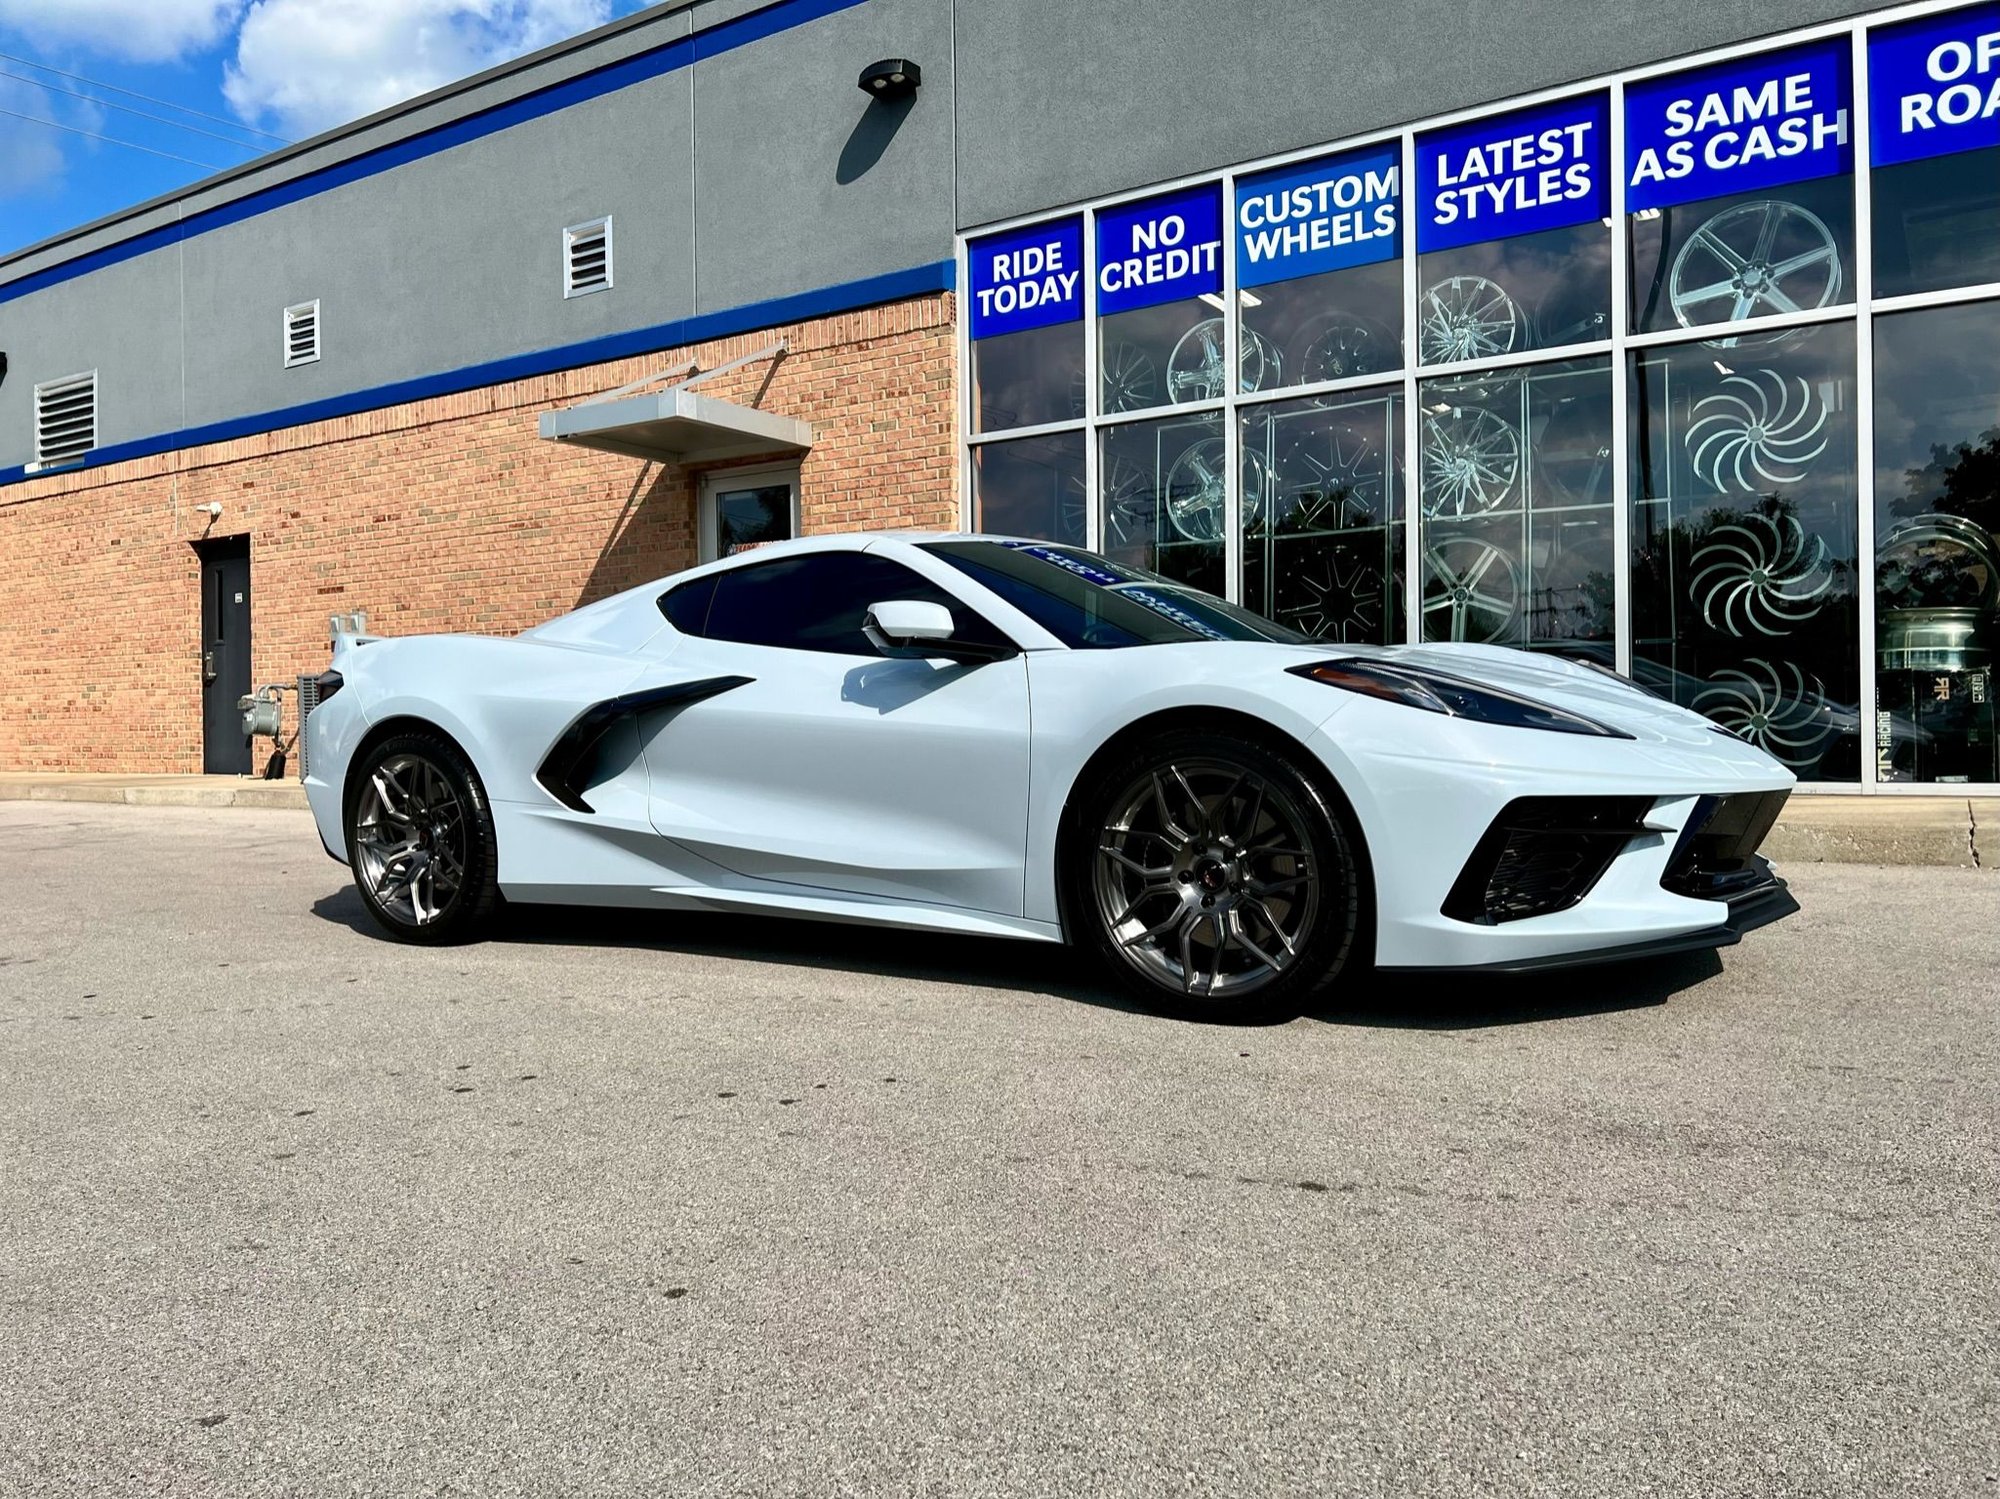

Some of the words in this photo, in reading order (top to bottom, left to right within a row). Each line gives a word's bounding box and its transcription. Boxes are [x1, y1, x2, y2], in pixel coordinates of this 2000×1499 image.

[1664, 73, 1813, 137] SAME
[1438, 121, 1593, 187] LATEST
[1630, 140, 1695, 187] AS
[1704, 108, 1848, 170] CASH
[1240, 165, 1399, 229] CUSTOM
[1433, 163, 1591, 225] STYLES
[993, 242, 1063, 283] RIDE
[1132, 215, 1185, 253] NO
[1244, 203, 1396, 263] WHEELS
[976, 270, 1079, 317] TODAY
[1100, 240, 1221, 293] CREDIT
